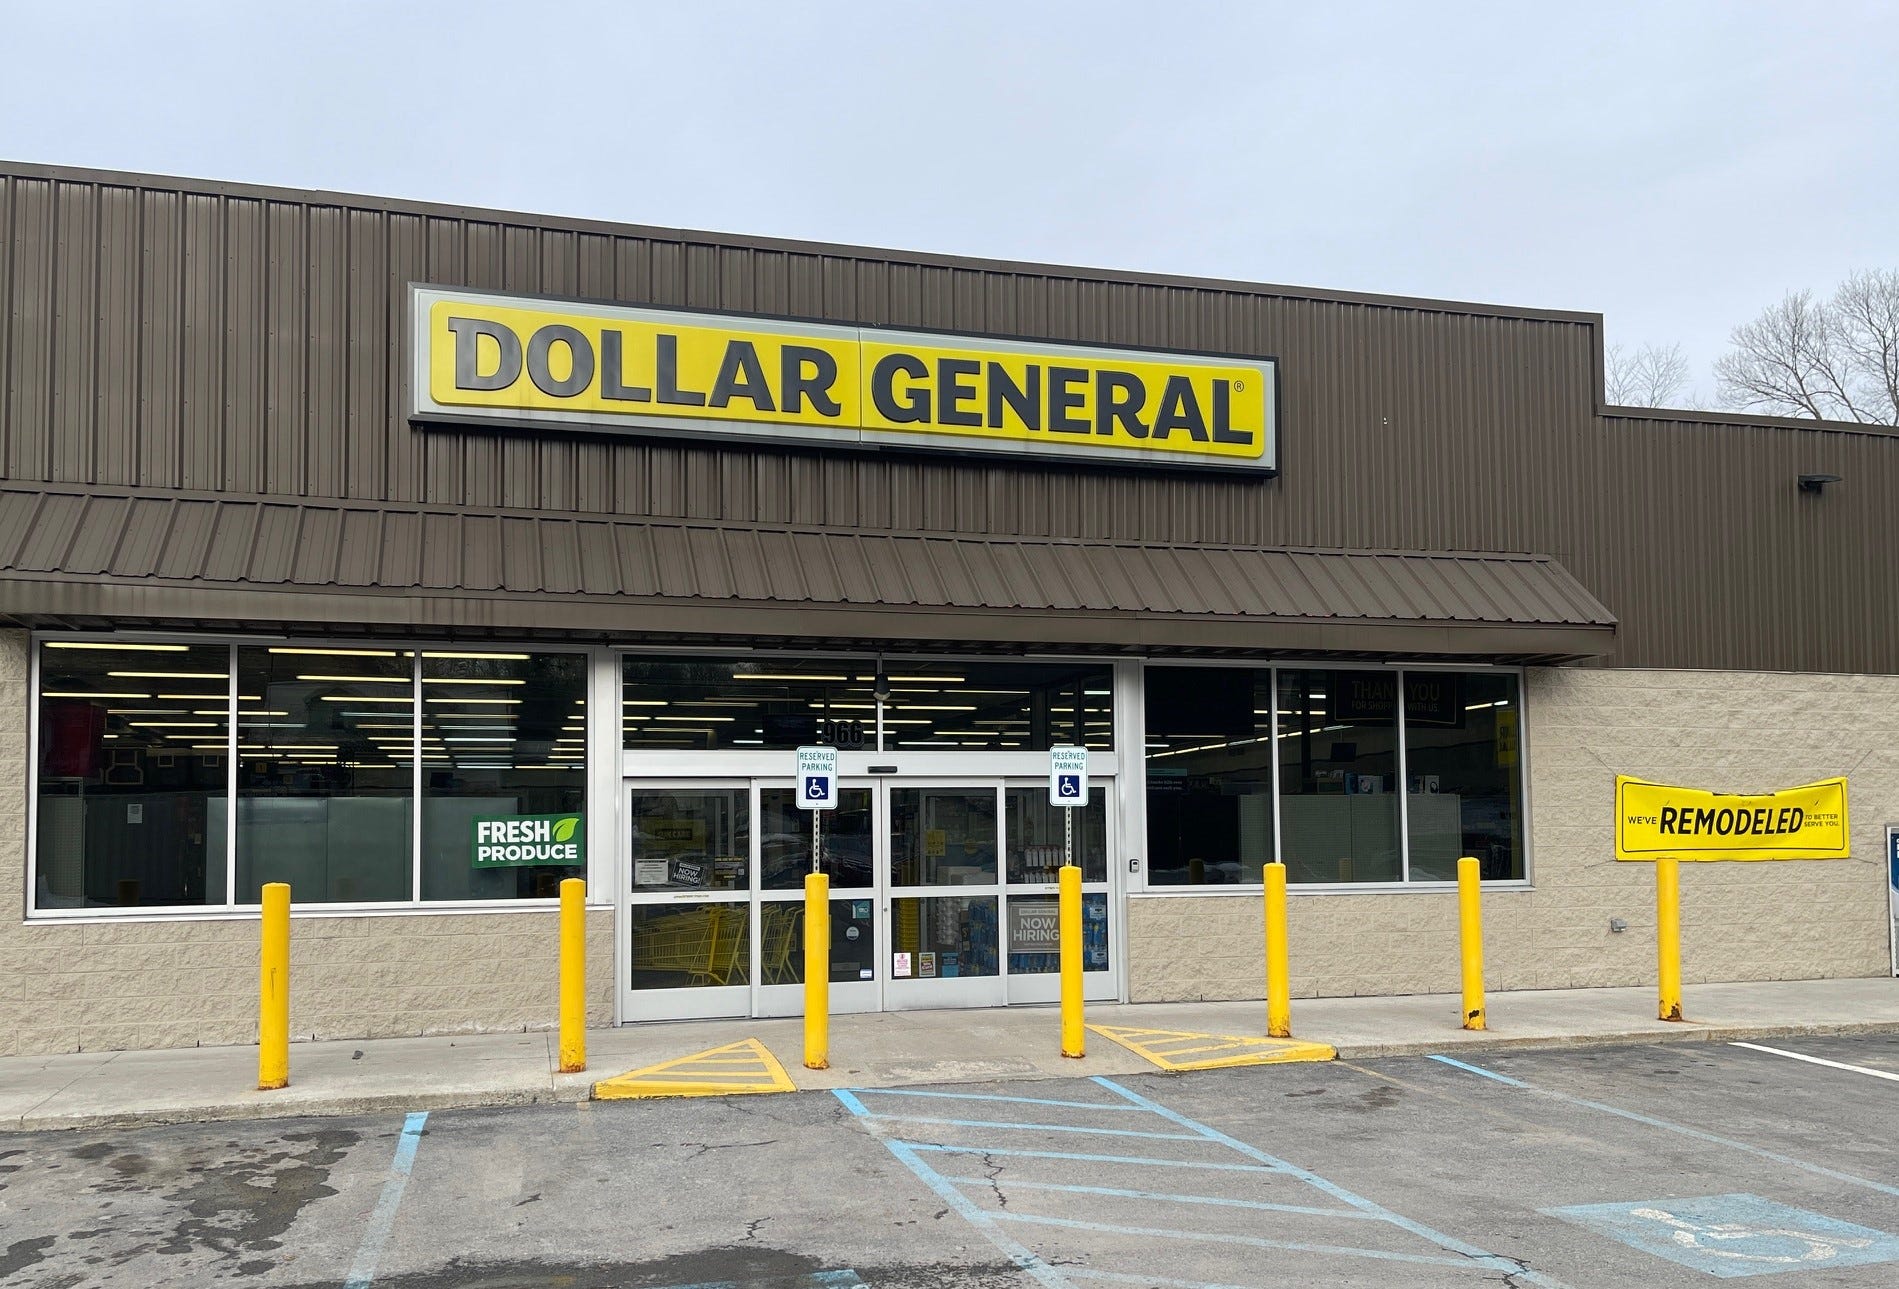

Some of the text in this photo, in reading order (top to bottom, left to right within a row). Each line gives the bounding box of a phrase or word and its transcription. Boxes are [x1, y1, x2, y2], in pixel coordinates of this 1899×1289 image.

[448, 316, 842, 418] DOLLAR
[1352, 680, 1440, 701] THAN YOU
[822, 721, 864, 746] 966
[799, 752, 835, 761] RESERVED
[1052, 752, 1086, 760] RESERVED
[801, 763, 833, 771] PARKING
[1054, 762, 1084, 770] PARKING
[1628, 806, 1804, 836] WE'VE REMODELED
[477, 820, 550, 844] FRESH
[477, 844, 578, 862] PRODUCE
[673, 872, 701, 884] HIRING!
[678, 867, 699, 877] NOW
[1020, 917, 1056, 929] NOW
[1013, 929, 1060, 941] HIRING
